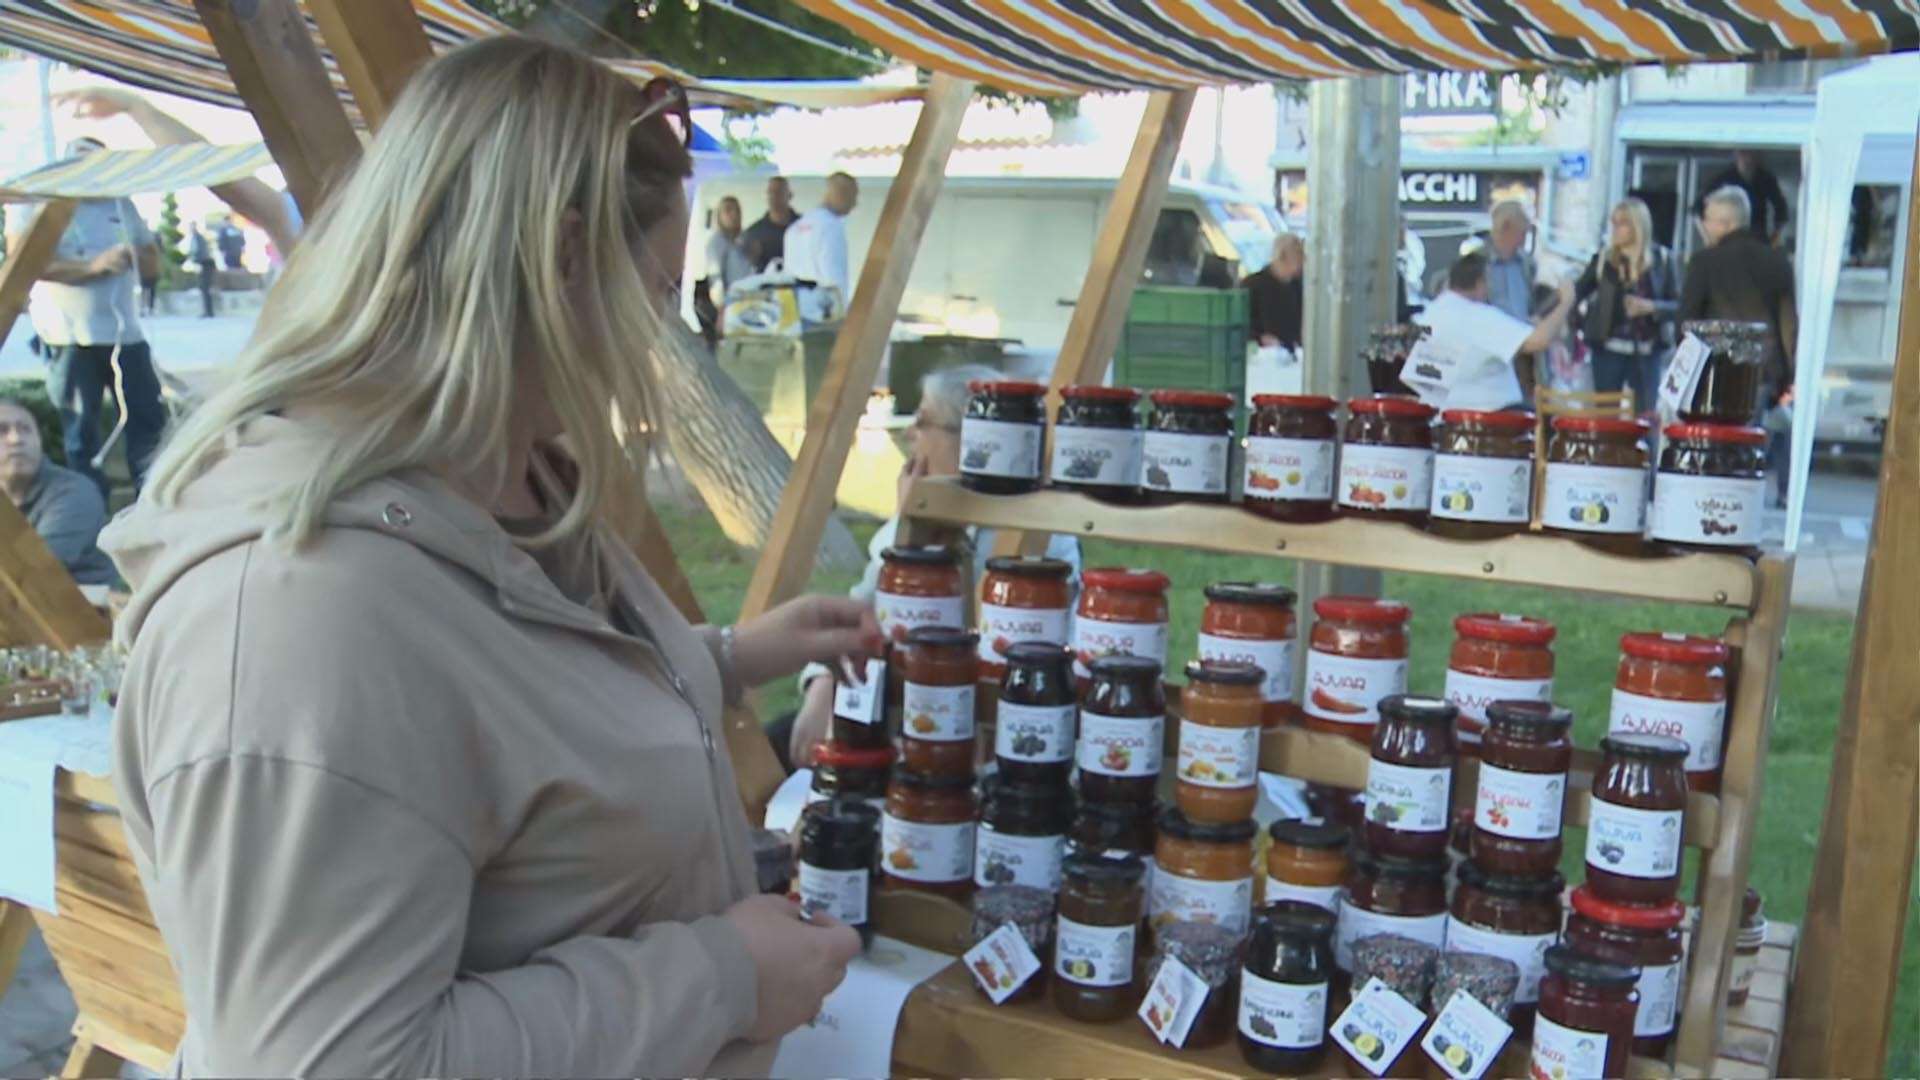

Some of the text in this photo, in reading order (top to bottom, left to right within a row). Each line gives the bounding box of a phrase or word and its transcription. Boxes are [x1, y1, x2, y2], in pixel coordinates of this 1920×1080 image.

[993, 619, 1043, 635] AJVAR
[1313, 672, 1366, 691] AJVAR
[1452, 691, 1492, 709] AJVA
[1621, 714, 1683, 736] AJVAR
